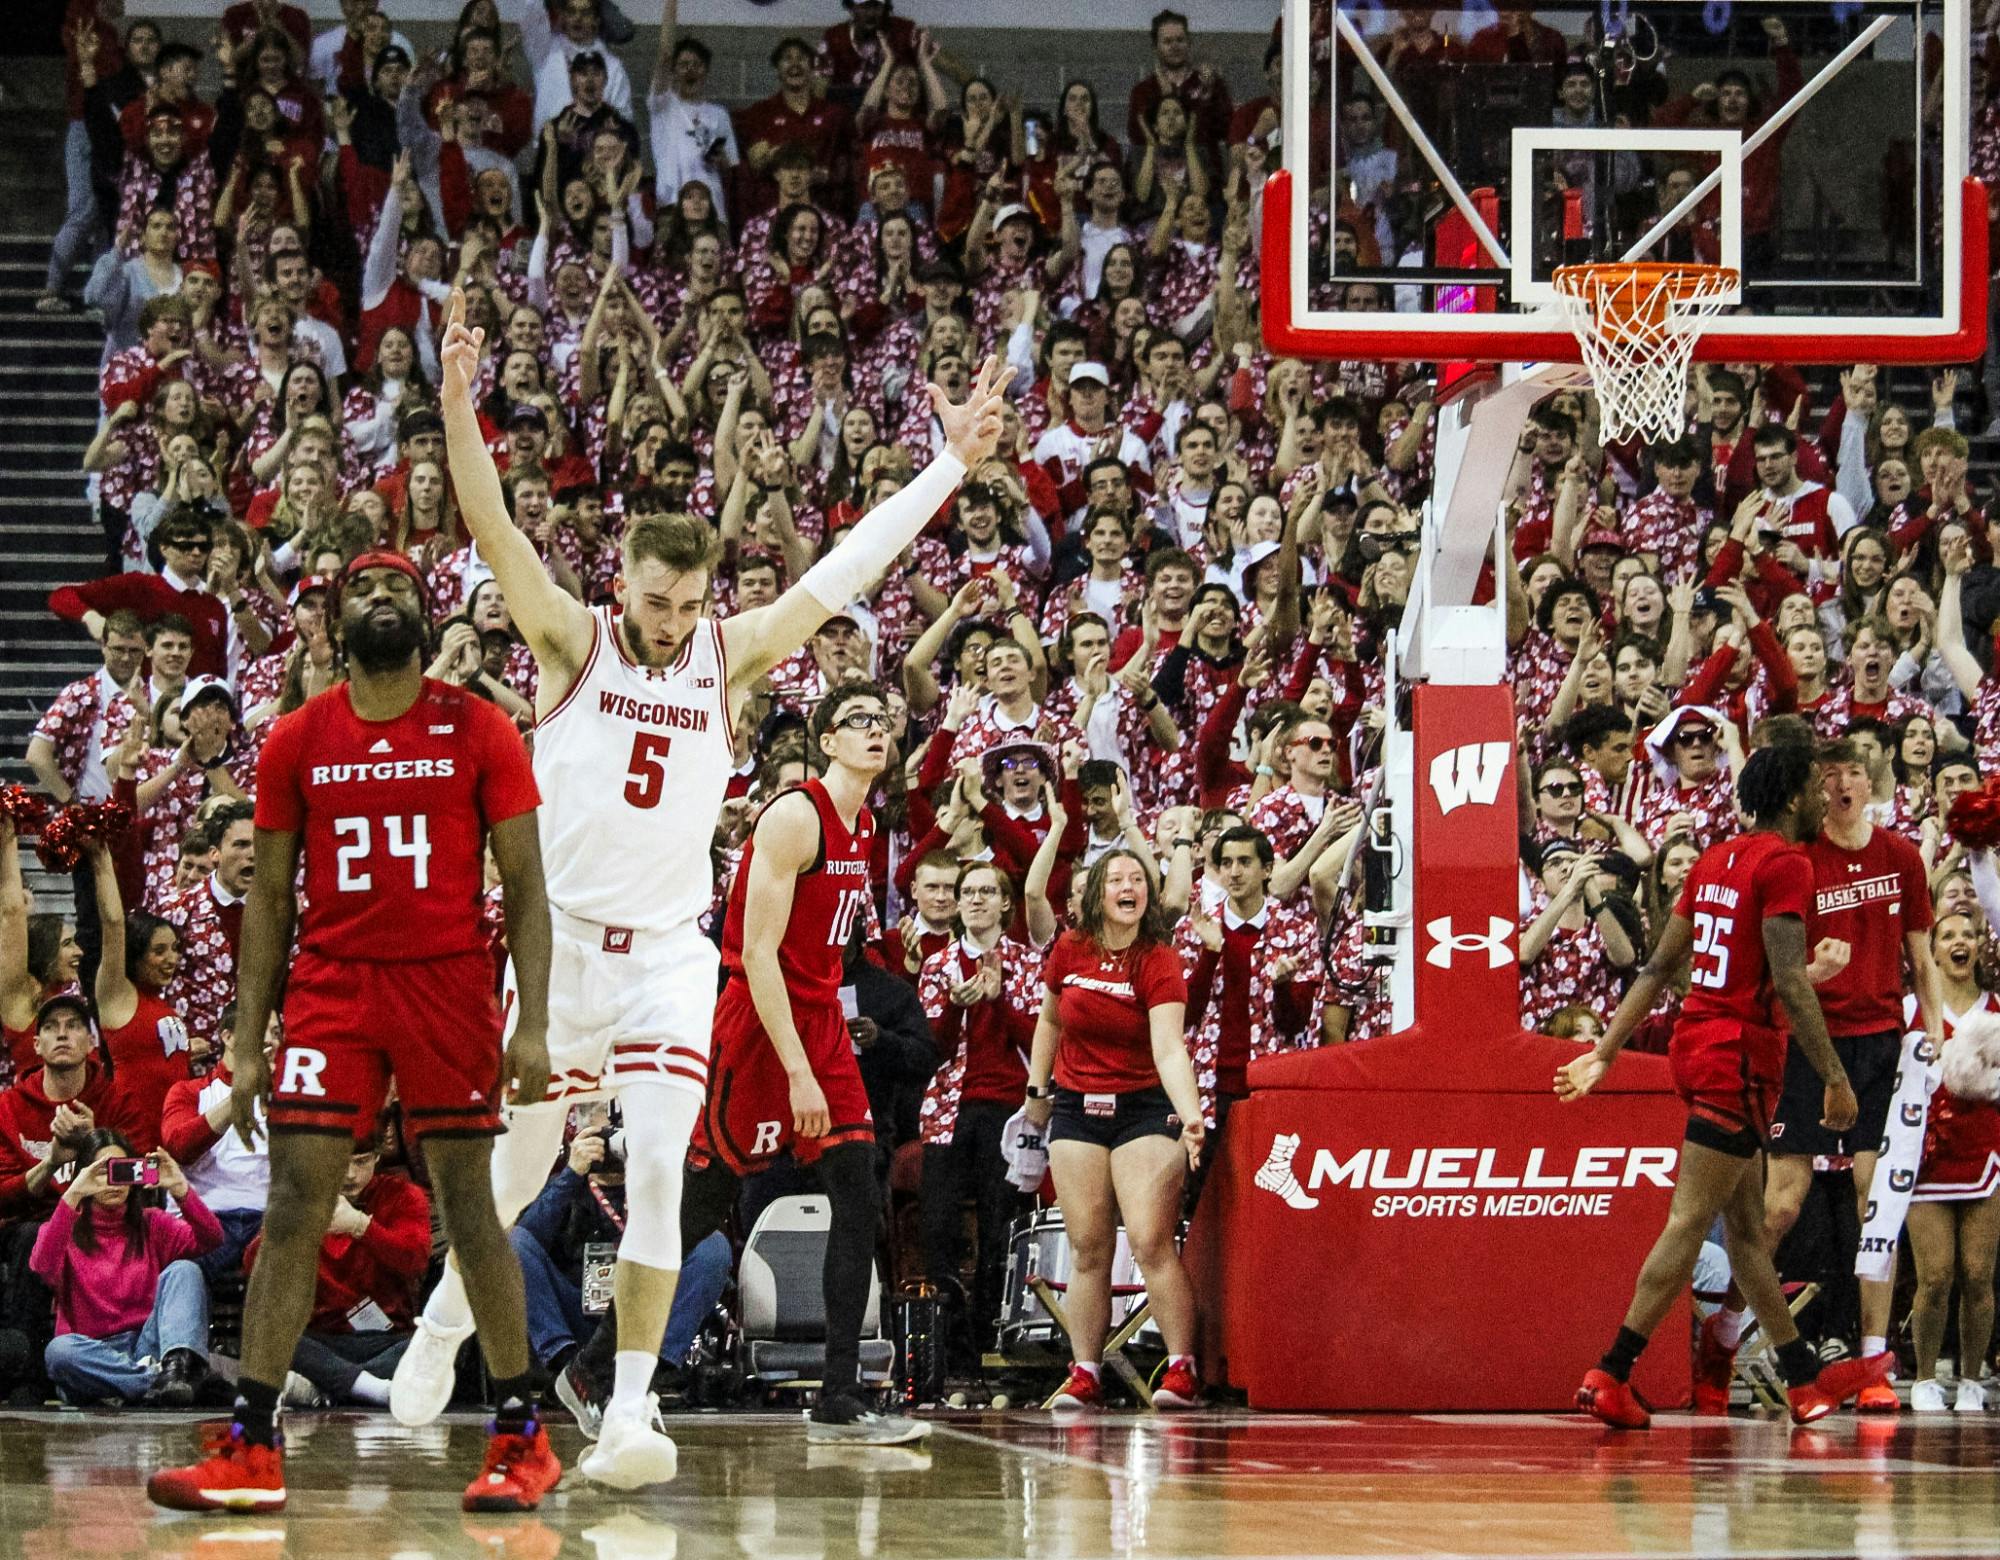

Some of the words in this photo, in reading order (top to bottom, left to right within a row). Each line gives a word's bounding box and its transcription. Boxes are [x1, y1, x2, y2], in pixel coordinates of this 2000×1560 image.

[599, 690, 709, 733] WISCONSIN
[312, 758, 456, 786] RUTGERS
[623, 731, 672, 810] 5
[1429, 741, 1511, 816] W
[334, 814, 432, 893] 24
[1816, 878, 1901, 910] BASKETBALL
[826, 889, 860, 946] 10
[279, 1046, 328, 1097] R
[750, 1120, 783, 1155] R
[1307, 1147, 1679, 1190] MUELLER
[1371, 1194, 1478, 1218] SPORTS
[1482, 1193, 1614, 1217] MEDICINE
